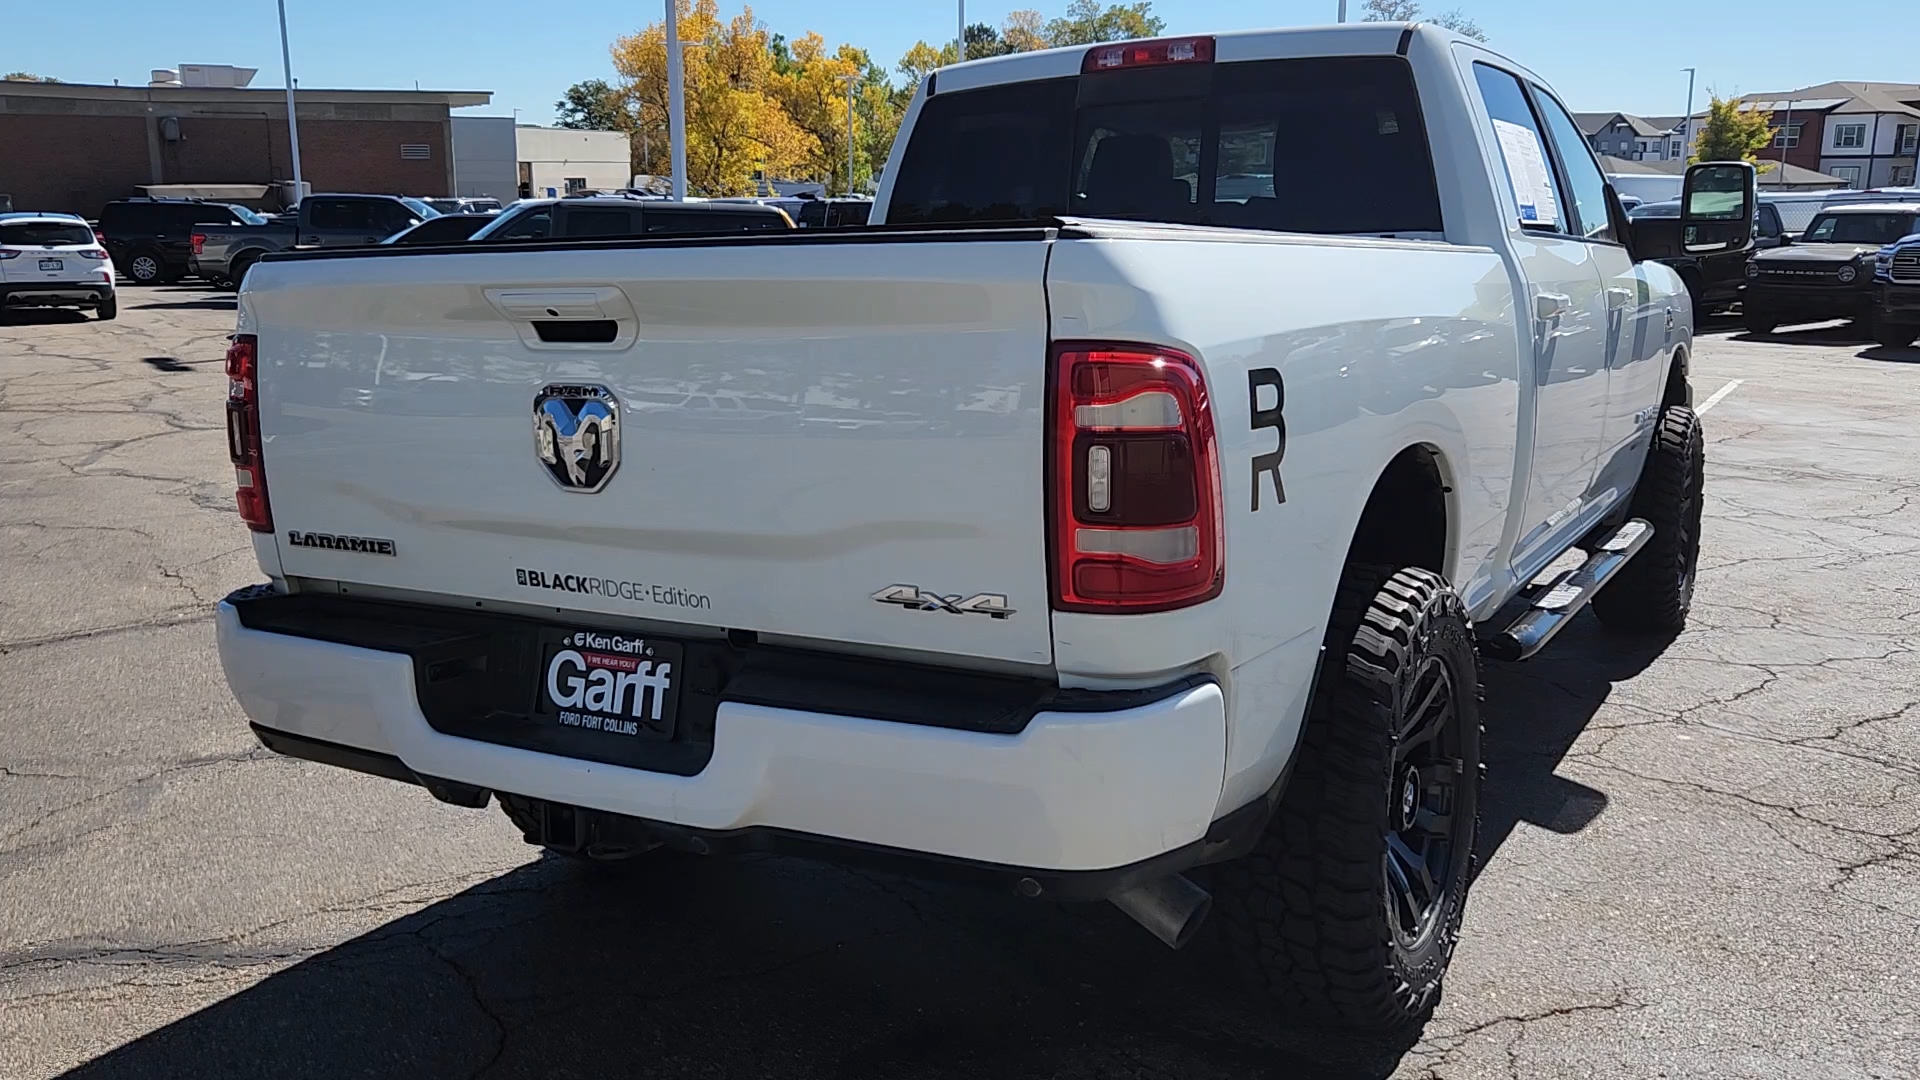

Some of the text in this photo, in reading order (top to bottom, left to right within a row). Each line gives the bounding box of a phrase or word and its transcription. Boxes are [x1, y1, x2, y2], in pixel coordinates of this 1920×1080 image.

[549, 387, 599, 398] RAM
[288, 530, 397, 557] LARAMIE
[586, 632, 644, 654] Ken Garff
[602, 658, 618, 666] HEAR
[620, 660, 632, 668] YOU
[547, 649, 672, 720] Garff
[560, 711, 638, 735] FORD FORT COLLINS
